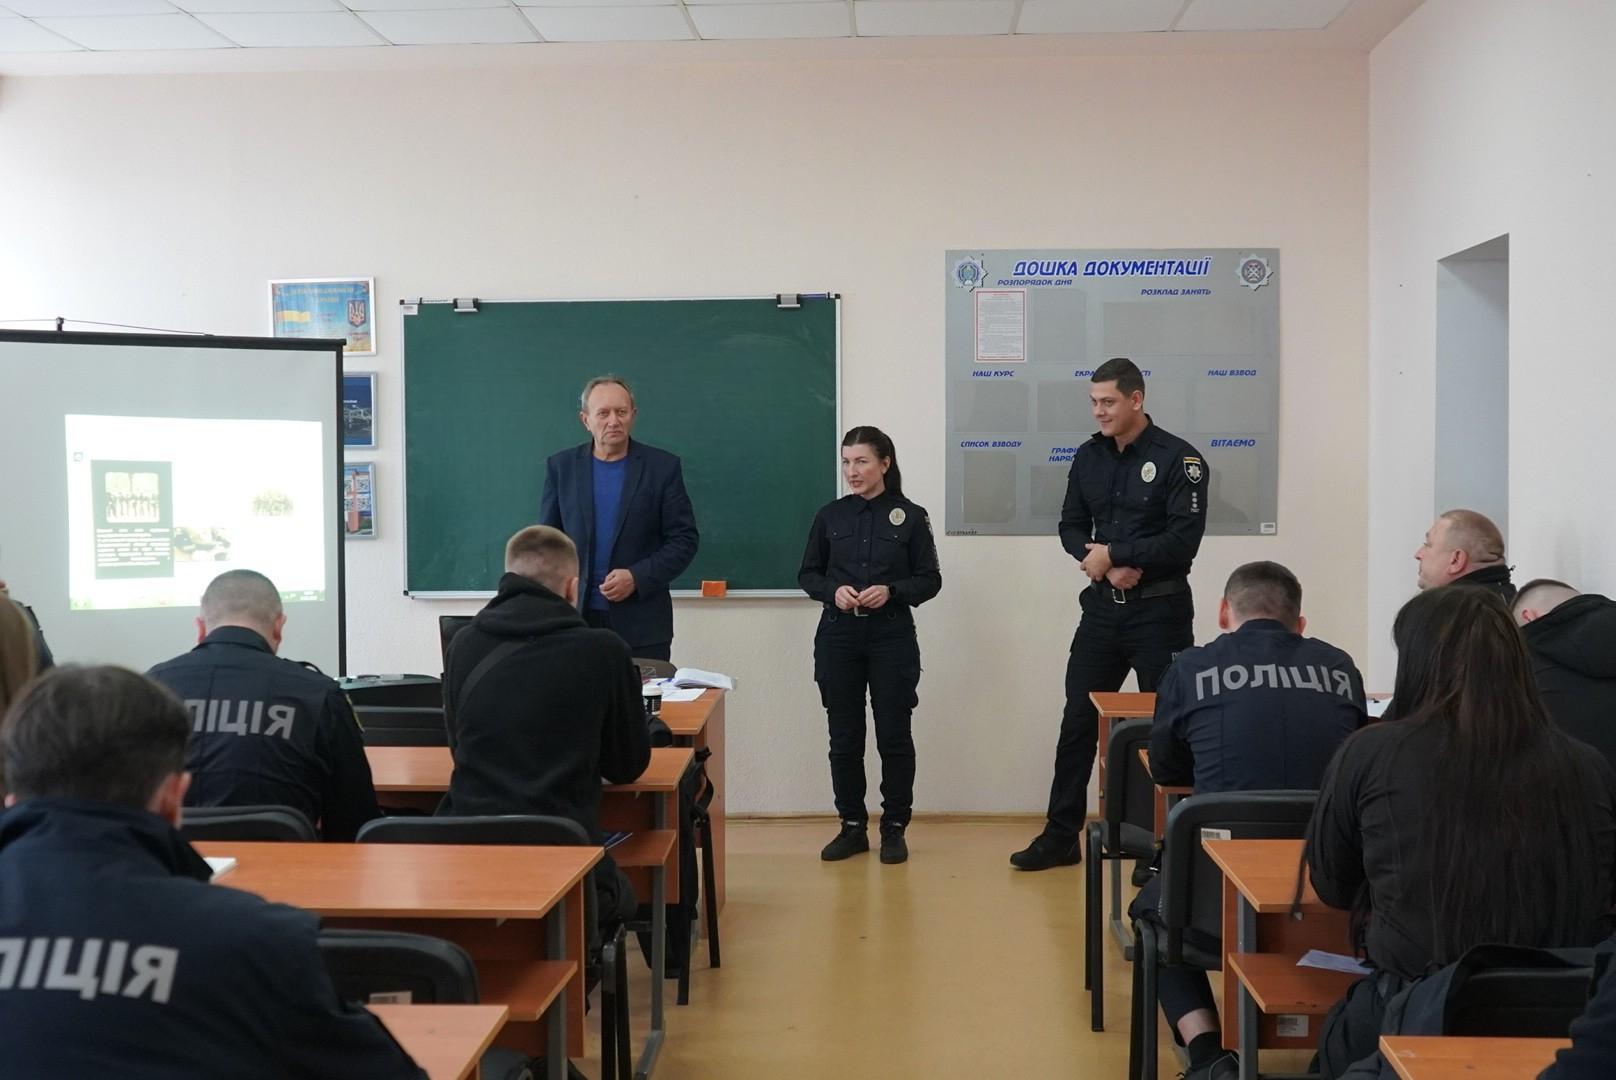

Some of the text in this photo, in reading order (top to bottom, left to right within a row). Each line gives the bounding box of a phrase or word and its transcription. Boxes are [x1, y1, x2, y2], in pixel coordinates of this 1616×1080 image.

[1012, 256, 1212, 277] ДОШКА ДОКУМЕНТАЦІЇ
[997, 279, 1073, 287] РОЗПОРЯДОК ДНЯ
[1140, 288, 1212, 296] РОЗКЛАД ЗАНЯТЬ
[972, 370, 1015, 378] НАШ КУРС
[1074, 370, 1097, 378] ЕКРА
[1207, 369, 1257, 378] НАШ ВЗВОД
[960, 440, 1022, 449] СПИСОК ВЗВОДУ
[1210, 439, 1257, 449] ВІТАЄМО
[1051, 447, 1080, 455] ГРАФІ
[1048, 455, 1074, 463] НАРЯ
[1195, 663, 1353, 701] ПОЛІЦІЯ
